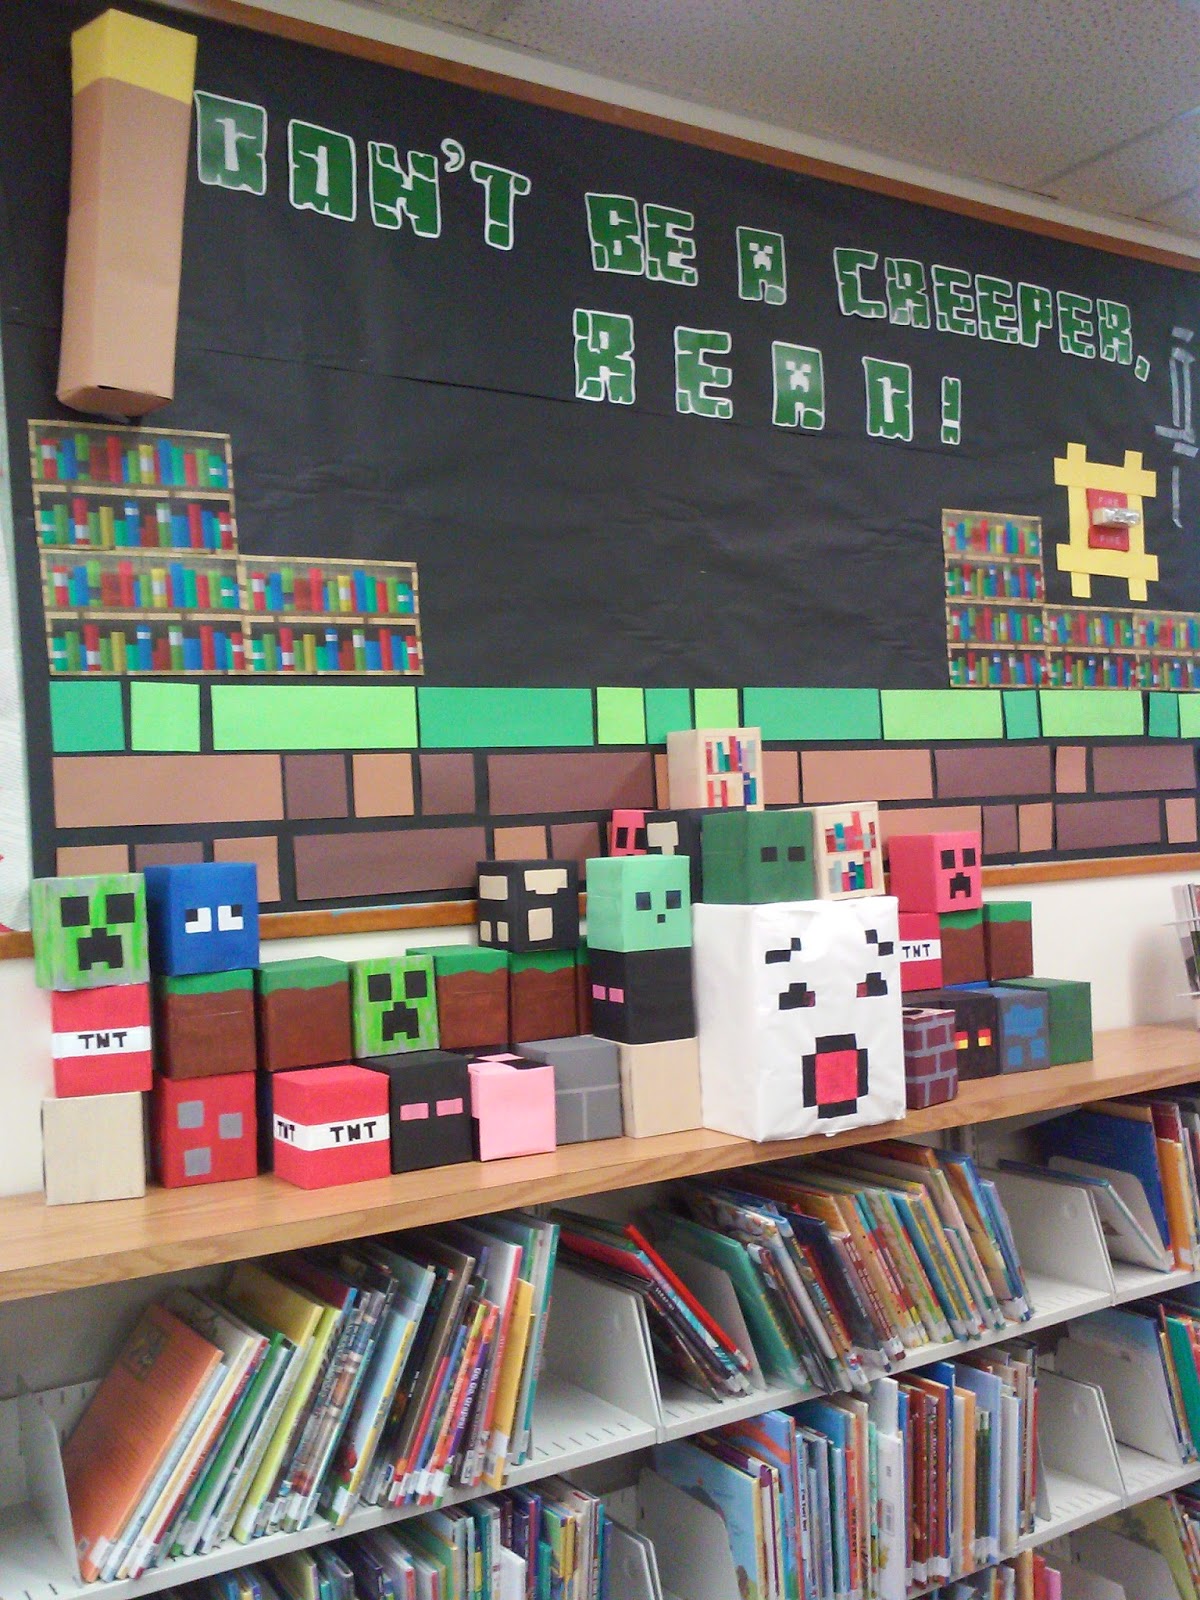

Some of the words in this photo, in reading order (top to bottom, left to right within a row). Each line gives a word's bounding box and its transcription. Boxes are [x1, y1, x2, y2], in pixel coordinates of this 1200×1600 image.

[195, 90, 531, 250] DON'T
[585, 192, 698, 286] BE
[736, 226, 787, 305] A
[833, 247, 1150, 381] CREEPER,
[902, 943, 931, 958] TNT
[78, 1031, 128, 1050] TNT
[277, 1121, 296, 1142] TNT
[330, 1121, 377, 1143] TNT
[470, 1367, 482, 1382] Go,
[466, 1382, 477, 1397] Go,
